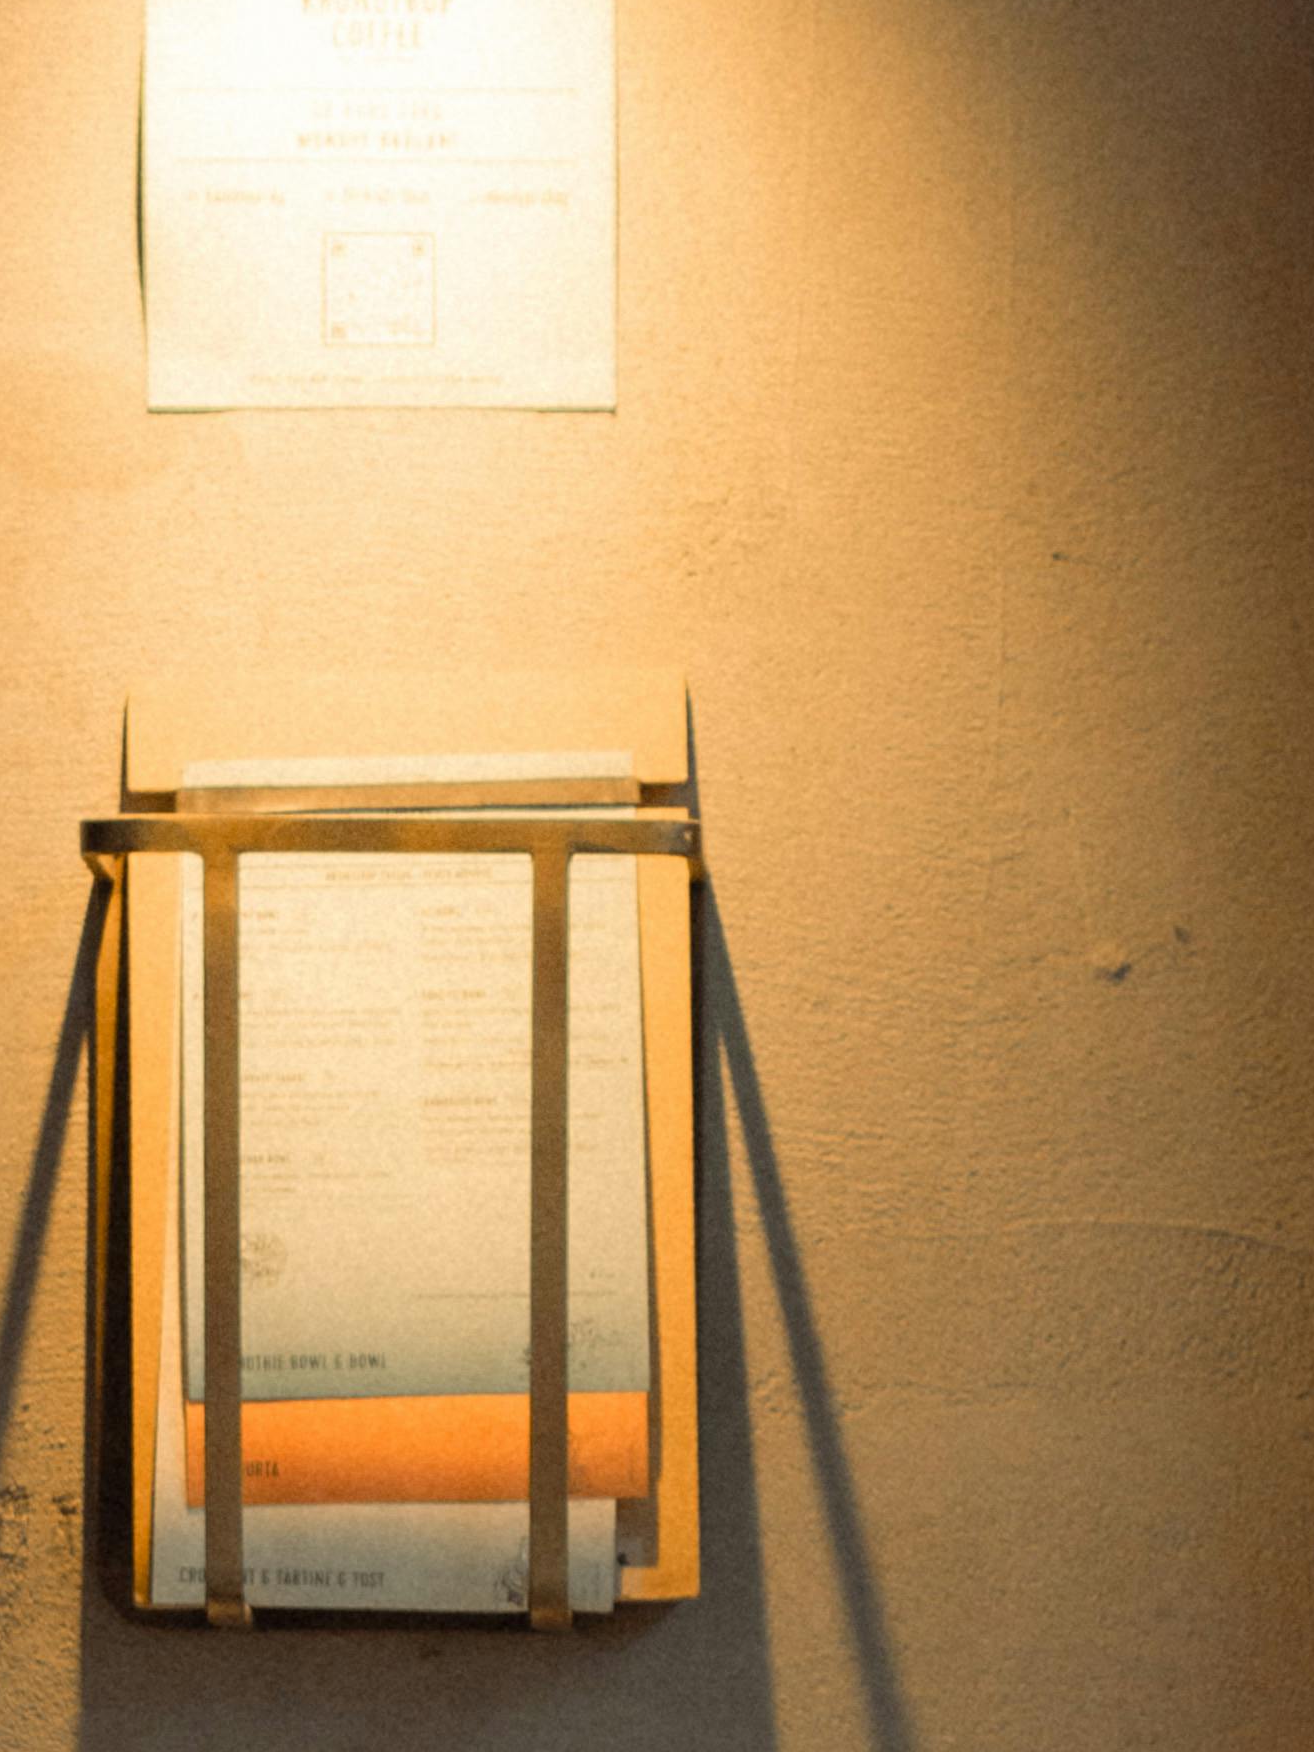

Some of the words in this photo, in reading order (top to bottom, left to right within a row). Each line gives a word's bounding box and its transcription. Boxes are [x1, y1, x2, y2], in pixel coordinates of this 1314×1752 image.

[289, 1353, 328, 1370] BOWL
[349, 1351, 386, 1369] BOWL
[352, 1571, 384, 1588] TOST
